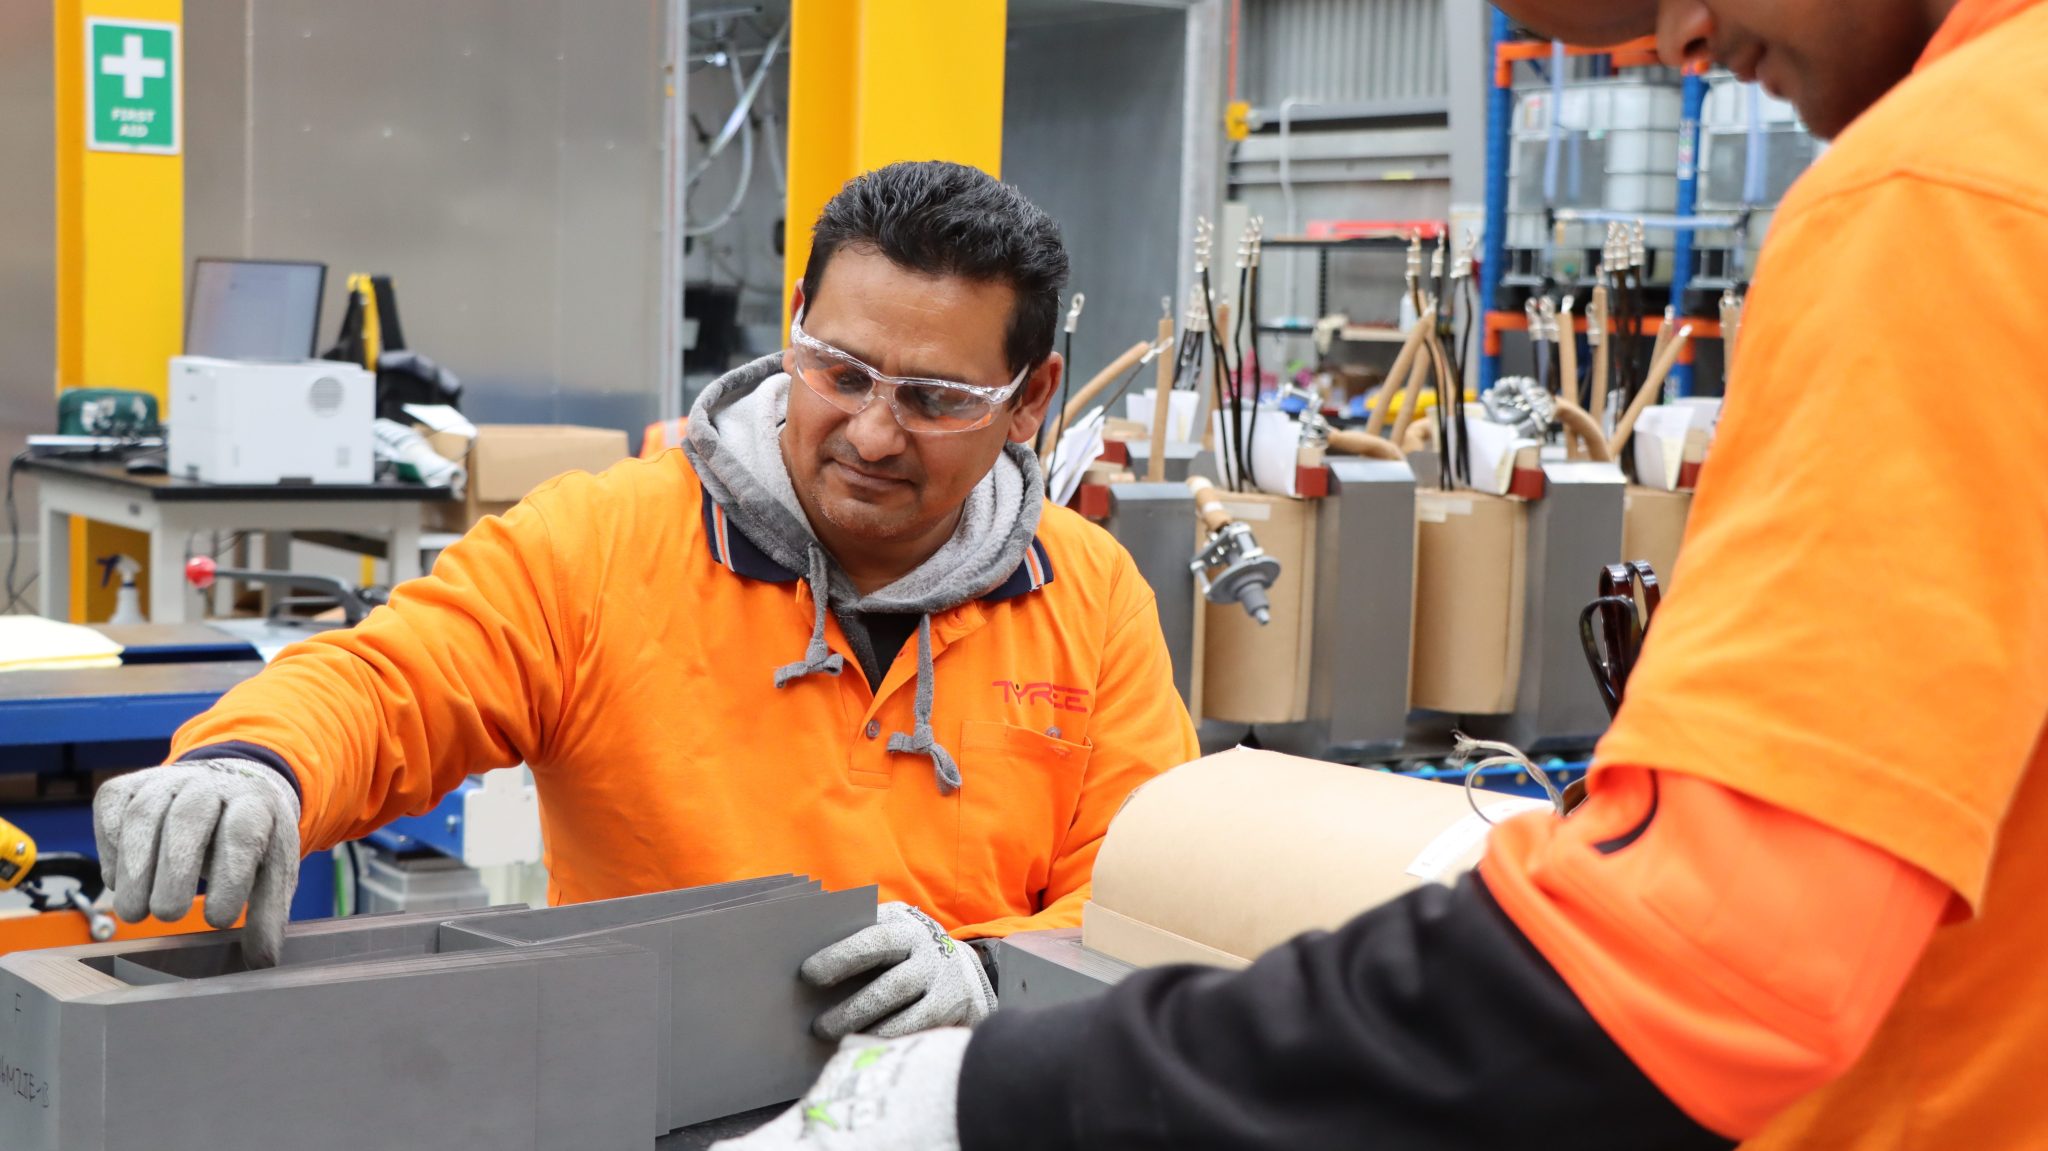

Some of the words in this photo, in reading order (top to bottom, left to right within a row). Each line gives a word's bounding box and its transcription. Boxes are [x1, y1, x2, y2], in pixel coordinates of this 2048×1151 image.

[110, 106, 156, 123] FIRST
[118, 123, 149, 138] AID
[991, 680, 1089, 713] TYREE
